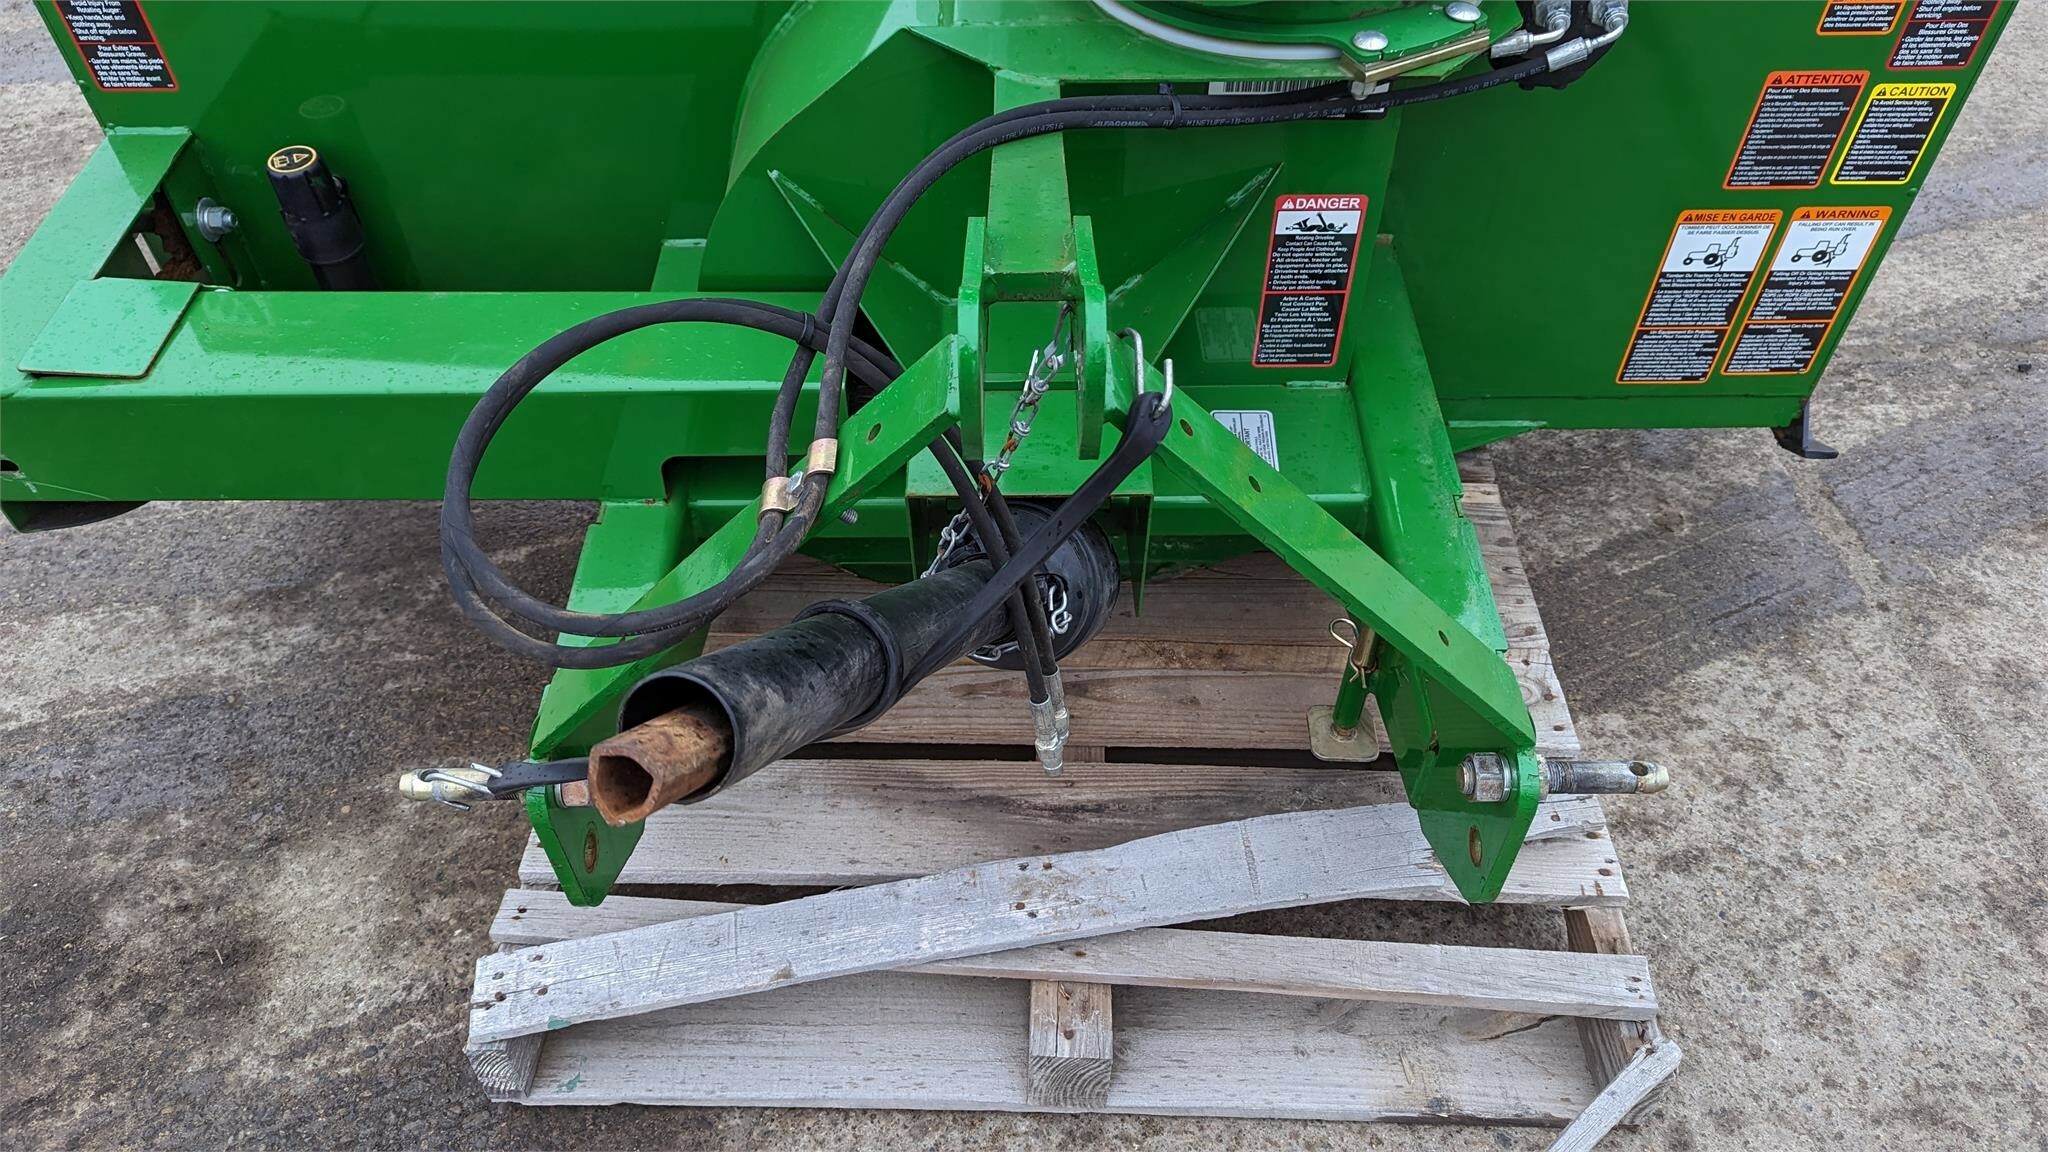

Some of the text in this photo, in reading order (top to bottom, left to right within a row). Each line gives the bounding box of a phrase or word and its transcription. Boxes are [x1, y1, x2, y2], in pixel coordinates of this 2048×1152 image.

[1785, 74, 1864, 84] ATTENTION
[1890, 86, 1951, 96] CAUTION
[1296, 198, 1360, 209] DANGER
[1694, 213, 1776, 221] MISE EN GARDE
[1816, 210, 1880, 218] WARNING
